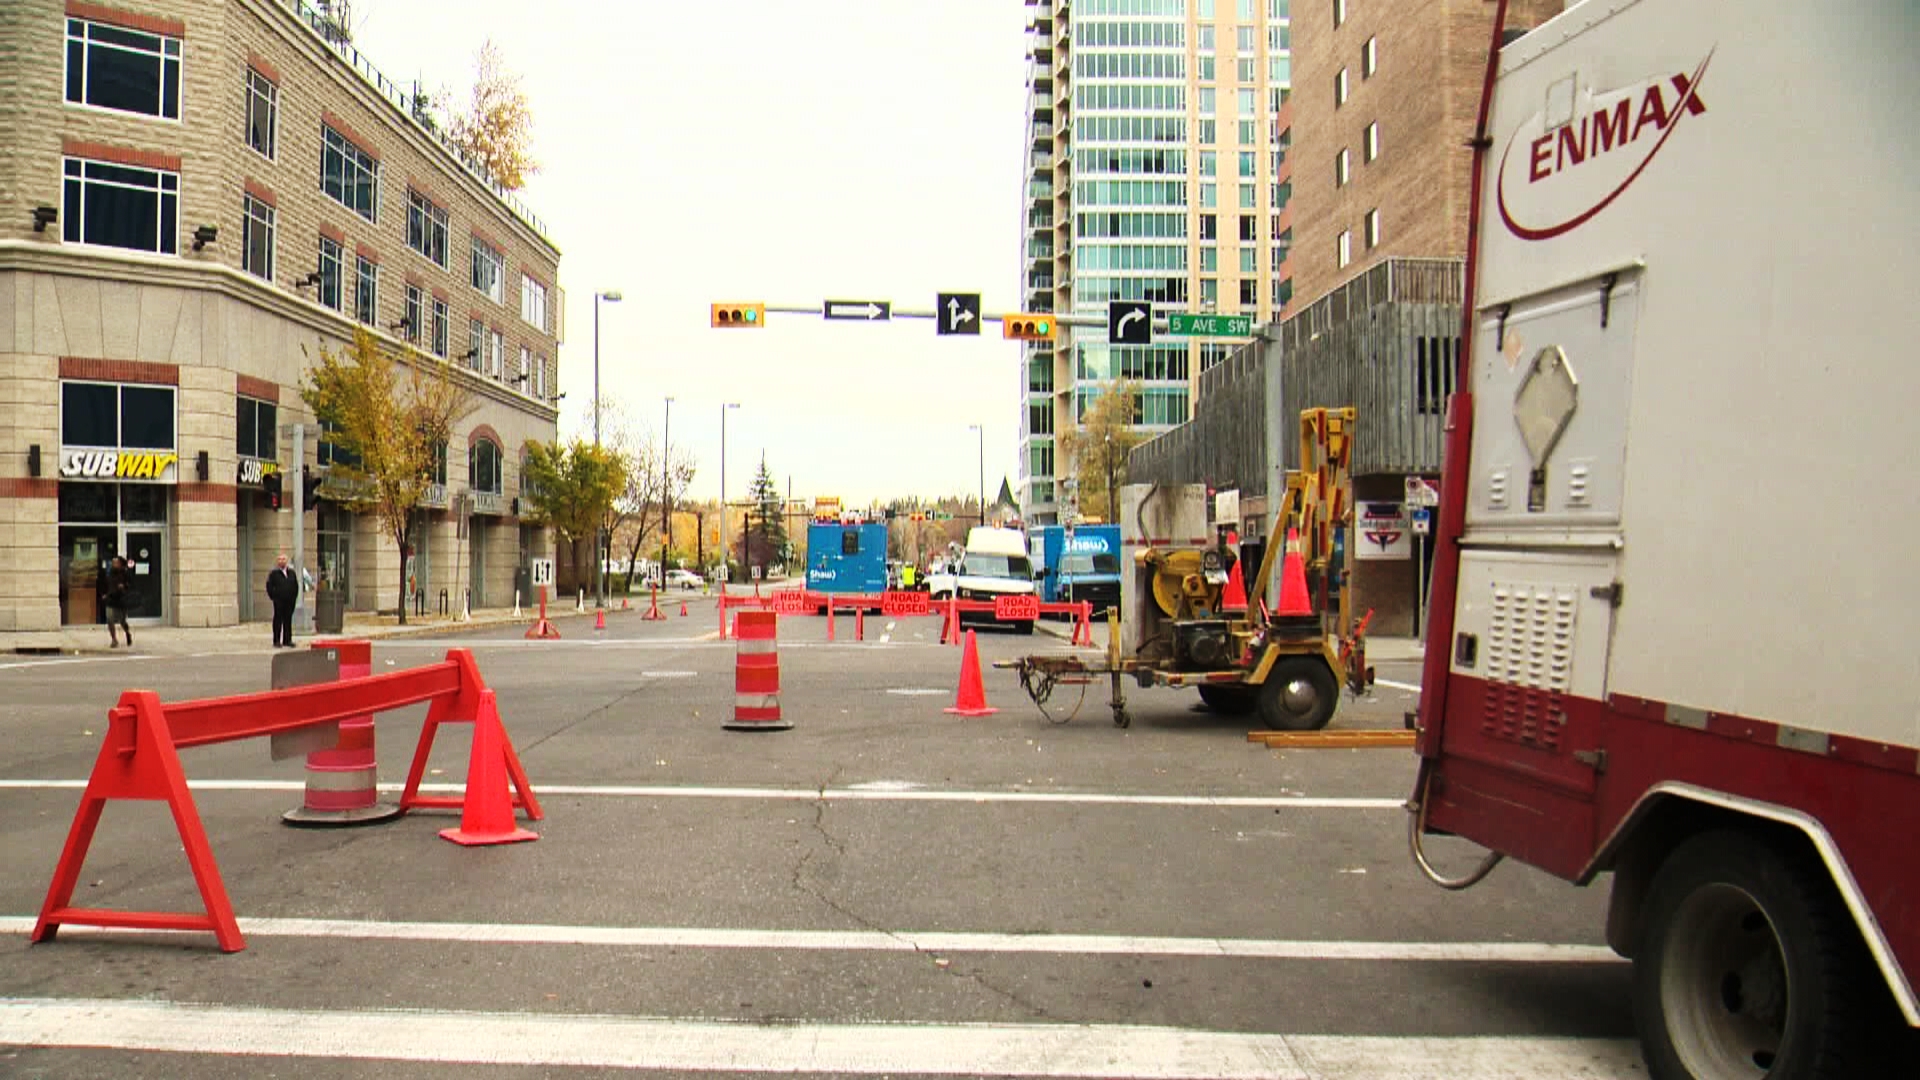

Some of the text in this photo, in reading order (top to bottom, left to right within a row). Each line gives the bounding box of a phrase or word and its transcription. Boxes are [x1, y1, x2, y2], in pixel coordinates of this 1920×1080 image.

[1528, 70, 1707, 184] ENMAX
[1173, 317, 1248, 333] 5 AVE SW
[60, 450, 178, 478] SUBWAY
[241, 459, 277, 483] SUB
[890, 593, 920, 603] ROAD
[1003, 597, 1031, 607] ROAD
[884, 602, 926, 613] CLOSED
[998, 607, 1037, 617] CLOSED
